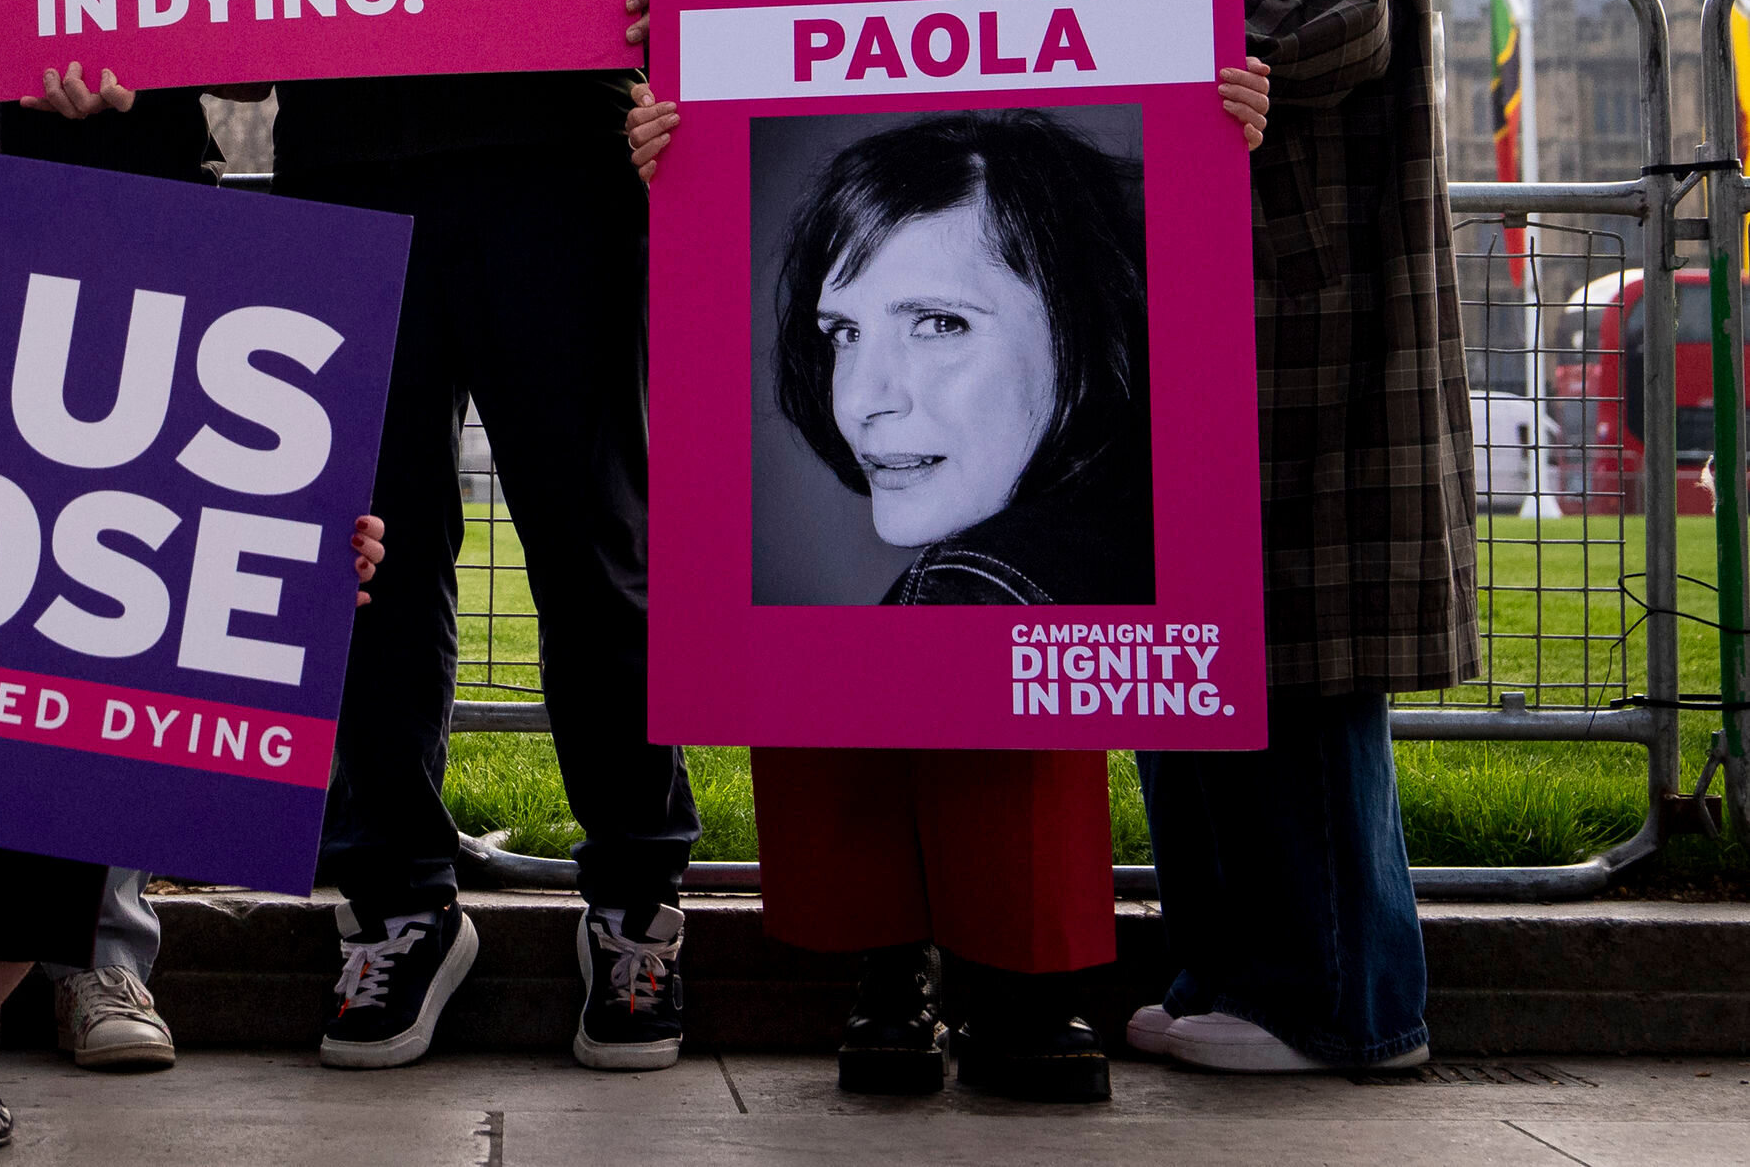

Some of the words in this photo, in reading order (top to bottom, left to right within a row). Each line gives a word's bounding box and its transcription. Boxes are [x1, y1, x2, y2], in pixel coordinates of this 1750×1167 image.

[793, 7, 1098, 83] PAOLA
[11, 272, 345, 497] US
[1011, 624, 1154, 644] CAMPAIGN
[1165, 624, 1220, 643] FOR
[1011, 645, 1219, 680] DIGNITY
[1012, 682, 1060, 715] IN
[1070, 682, 1235, 716] DYING.
[101, 699, 292, 767] DYING
